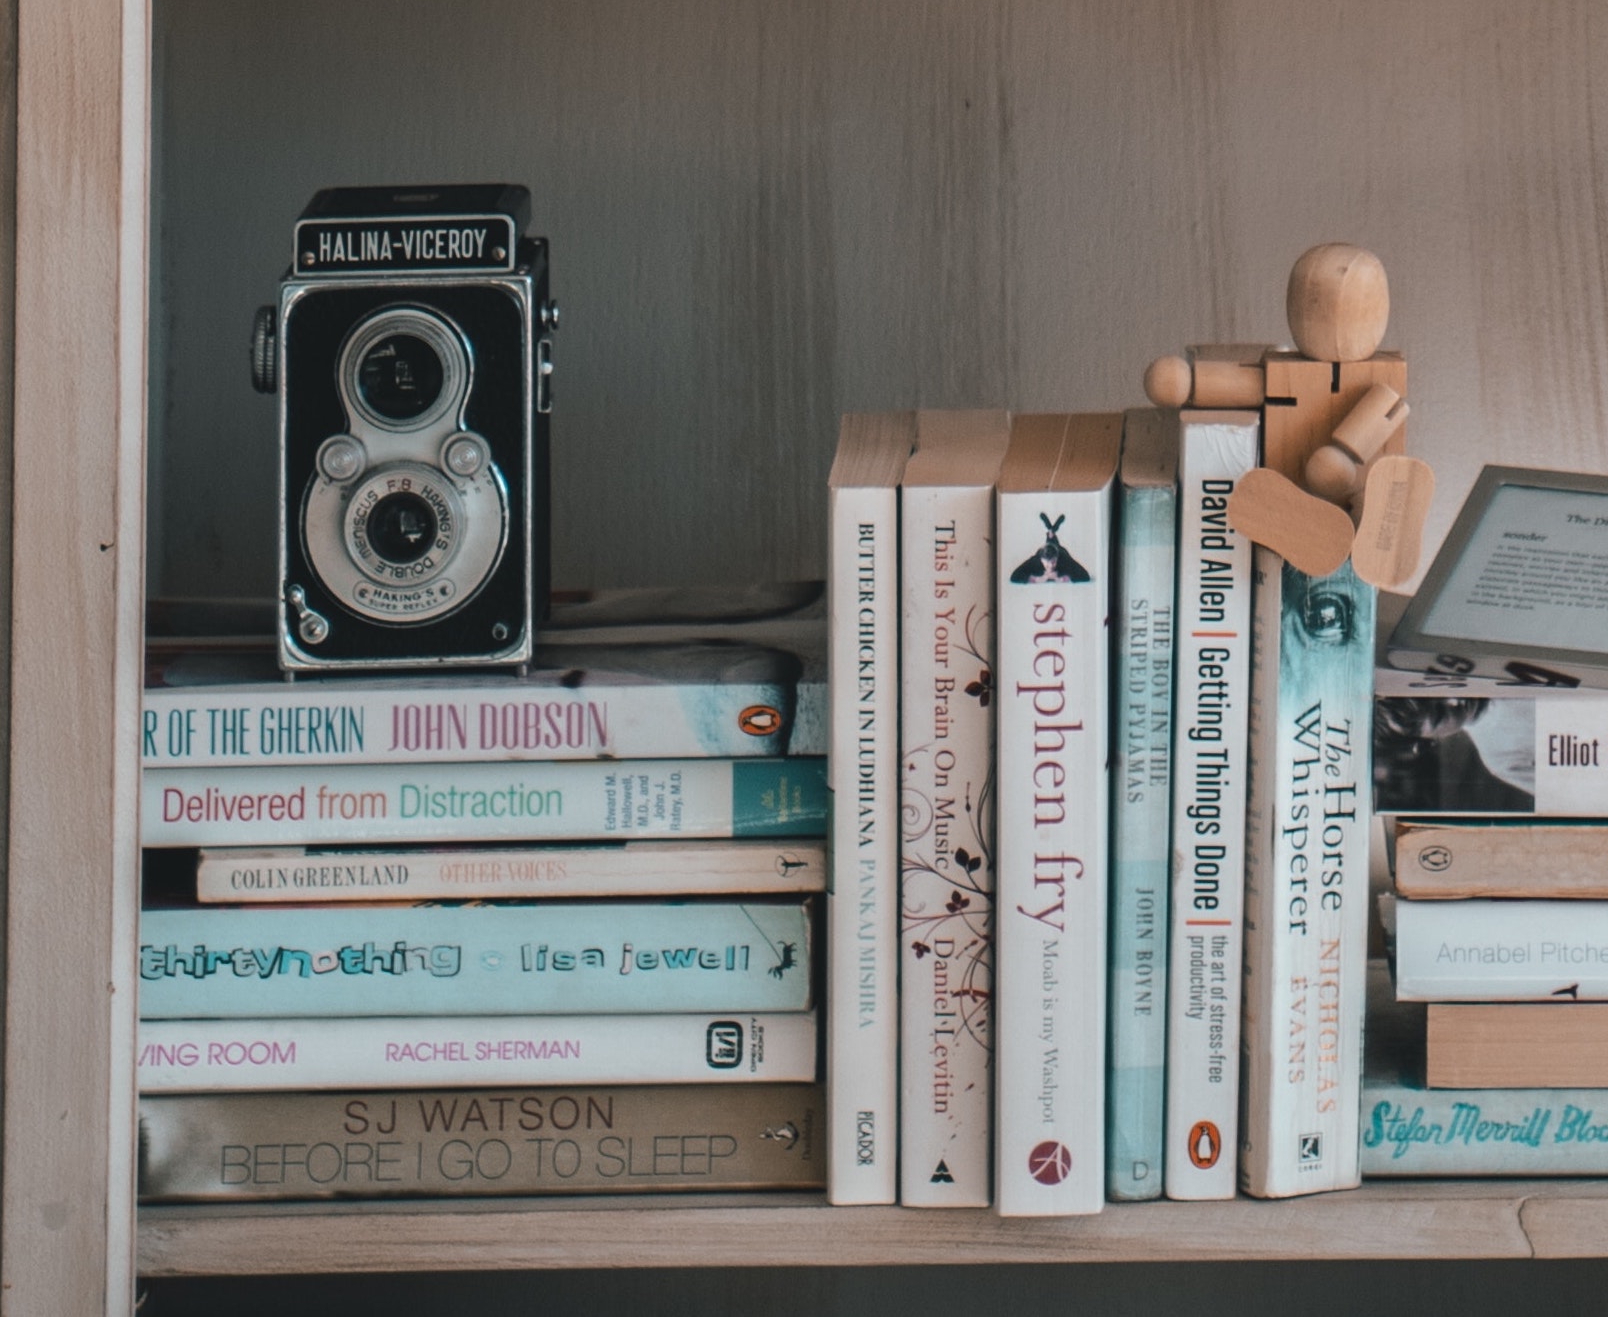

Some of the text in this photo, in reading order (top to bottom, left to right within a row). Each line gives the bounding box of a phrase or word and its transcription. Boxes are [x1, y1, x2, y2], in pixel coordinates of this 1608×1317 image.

[319, 229, 486, 262] HALINA-VICEROY
[1566, 514, 1590, 525] The
[1192, 479, 1235, 910] David Allen Getting Things Done
[1547, 736, 1601, 766] Elliot
[163, 786, 564, 822] Delivered from Distraction
[1016, 603, 1084, 1123] stephen fry Moab is my Washpot
[208, 1040, 581, 1063] ROOM RACHEL SHERMAN
